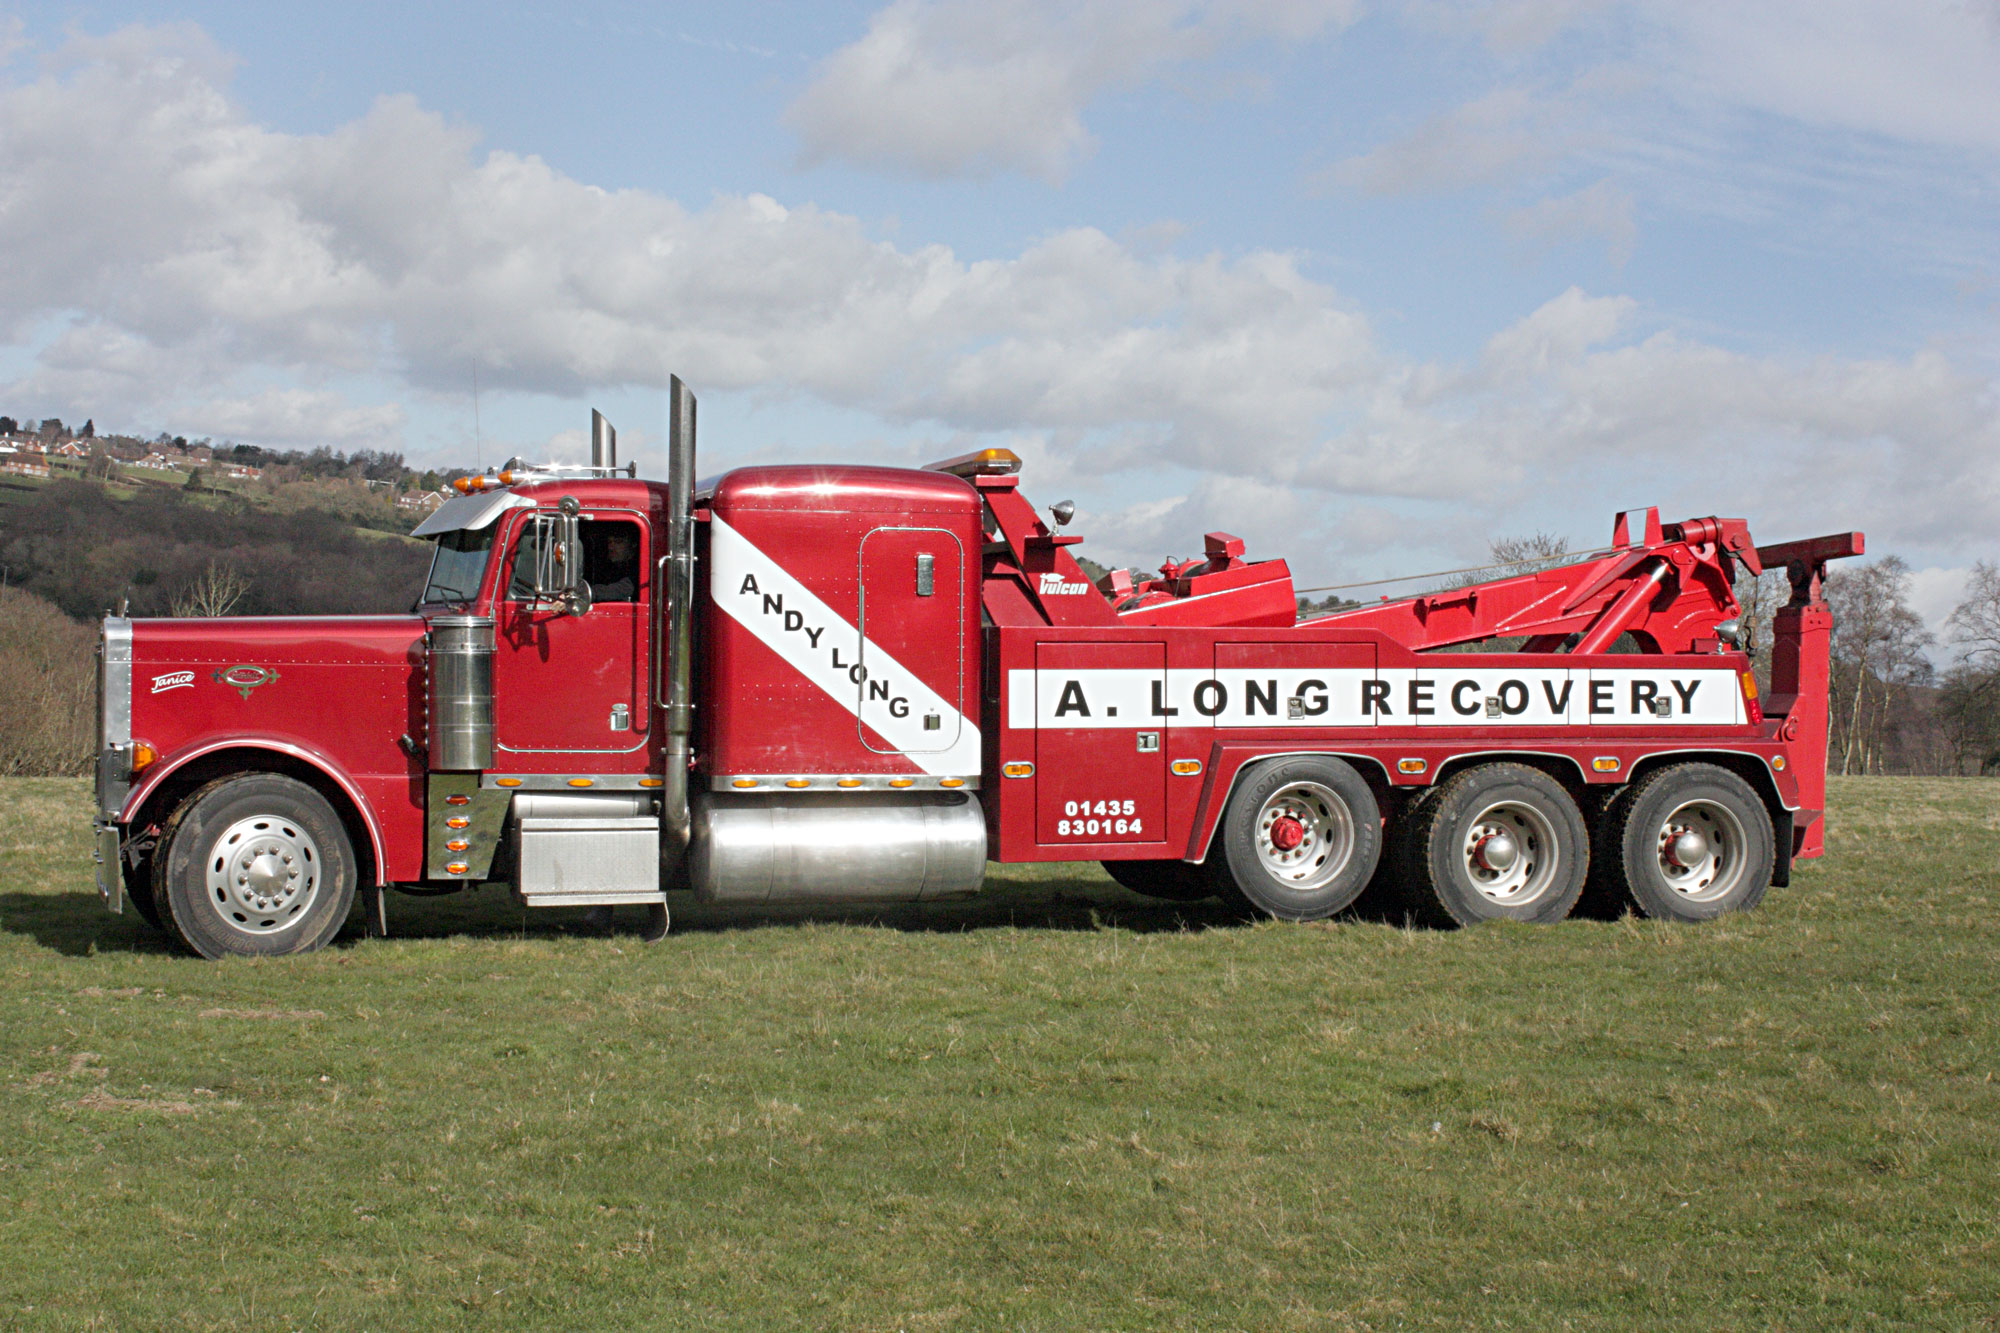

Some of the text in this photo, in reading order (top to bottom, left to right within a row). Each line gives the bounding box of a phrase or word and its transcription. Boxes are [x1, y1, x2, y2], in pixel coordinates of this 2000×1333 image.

[739, 573, 910, 718] ANDY LONG
[151, 672, 195, 691] Janice
[1054, 679, 1702, 717] A. LONG RECOVERY
[1065, 800, 1135, 816] 01435
[1057, 818, 1142, 836] 830164
